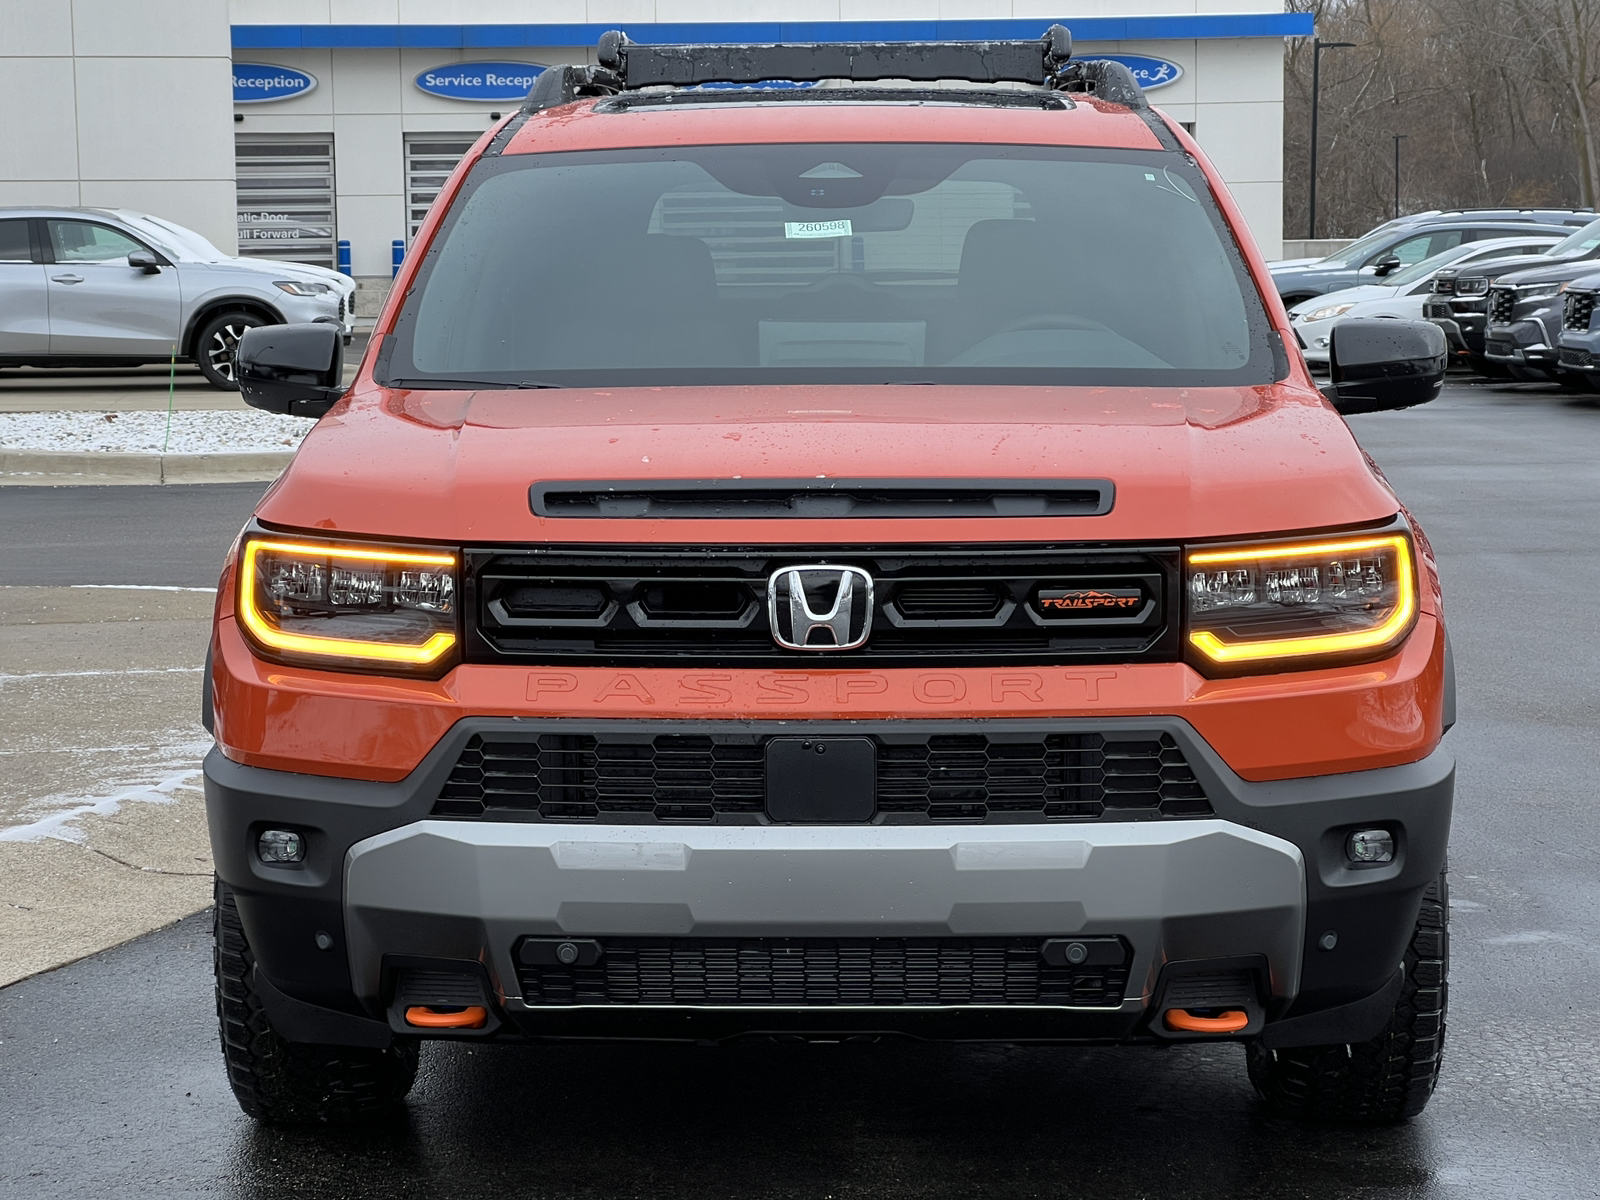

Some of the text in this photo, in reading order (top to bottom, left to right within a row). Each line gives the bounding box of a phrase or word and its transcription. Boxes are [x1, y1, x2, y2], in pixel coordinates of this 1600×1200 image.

[425, 74, 538, 89] Service Recept
[260, 212, 289, 221] Door
[798, 221, 845, 232] 260598
[237, 229, 300, 239] ull Forward
[1041, 598, 1139, 609] TRAILSPORT
[525, 671, 1117, 704] PASSPORT
